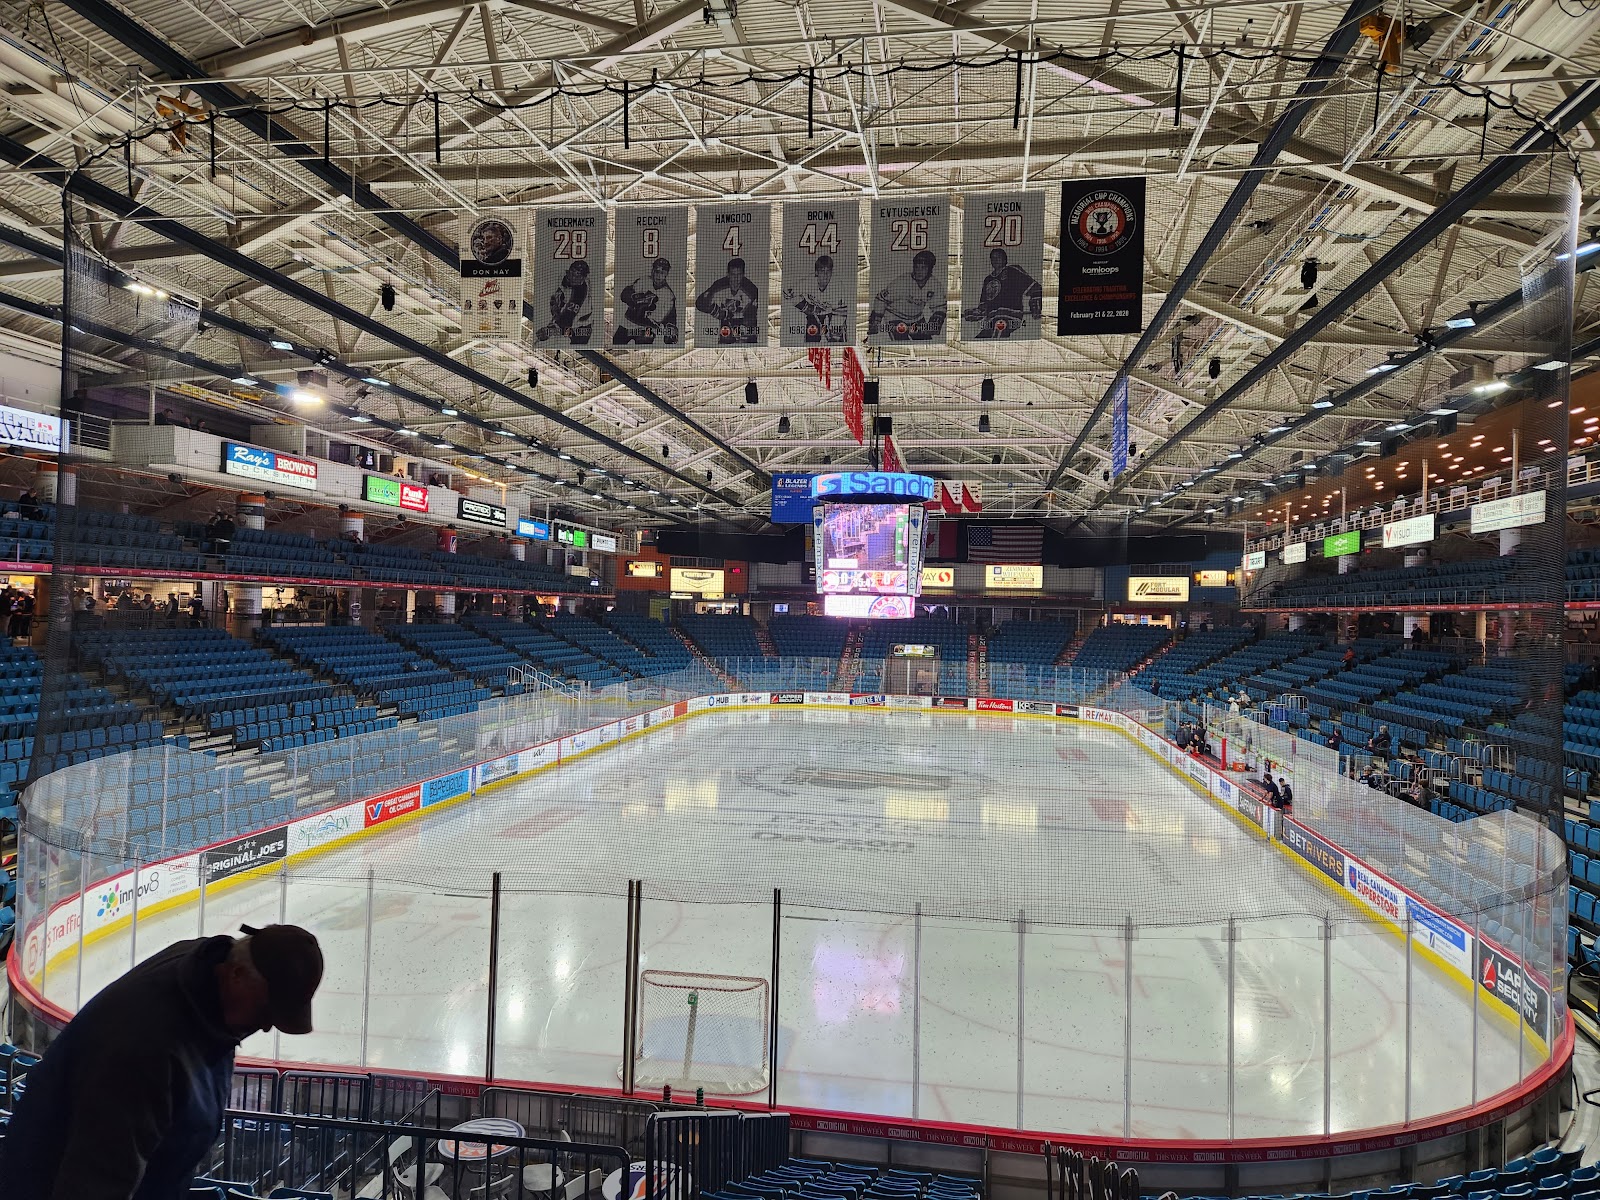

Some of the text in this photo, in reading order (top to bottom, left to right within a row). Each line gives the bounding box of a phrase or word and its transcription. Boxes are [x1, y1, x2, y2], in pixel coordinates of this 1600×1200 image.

[636, 216, 667, 226] RECCHI
[808, 211, 834, 220] BROWN
[880, 206, 940, 218] EVTUSHEVSKI
[987, 202, 1022, 213] EVASON
[1071, 192, 1134, 224] MEMORIAL CUP CHAMPIONS
[548, 218, 595, 228] NIEDERMAYER
[890, 219, 928, 252] 26
[984, 215, 1022, 248] 20
[554, 230, 588, 260] 28
[642, 228, 660, 258] 8
[722, 226, 742, 256] 4
[798, 222, 842, 254] 44
[1082, 266, 1120, 274] kamloops
[234, 446, 270, 466] Ray's
[232, 463, 312, 484] LOCKSMITH
[910, 533, 919, 590] remax.ca
[716, 696, 730, 704] HUB
[978, 700, 1012, 710] Tim Hortons
[1086, 710, 1112, 722] RE/MAX
[384, 790, 420, 808] GREAT CANADIAN
[397, 800, 414, 812] CHANGE
[206, 840, 284, 875] ORIGINAL JOE'S
[1290, 829, 1343, 876] BETRIVERS
[1358, 870, 1398, 904] REAL CANADIAN
[1358, 882, 1398, 919] SUPERSTORE
[52, 914, 81, 942] Traffic
[795, 1119, 812, 1128] WEEK
[852, 1124, 866, 1132] THIS
[866, 1127, 884, 1136] WEEK
[926, 1132, 940, 1141] THIS
[940, 1134, 958, 1144] WEEK
[1002, 1140, 1016, 1150] THIS
[1016, 1142, 1034, 1152] WEEK
[1156, 1152, 1170, 1161] THIS
[1170, 1153, 1189, 1162] WEEK
[1231, 1152, 1244, 1160] THIS
[1245, 1152, 1262, 1160] WEEK
[1314, 1148, 1330, 1156] WEEK
